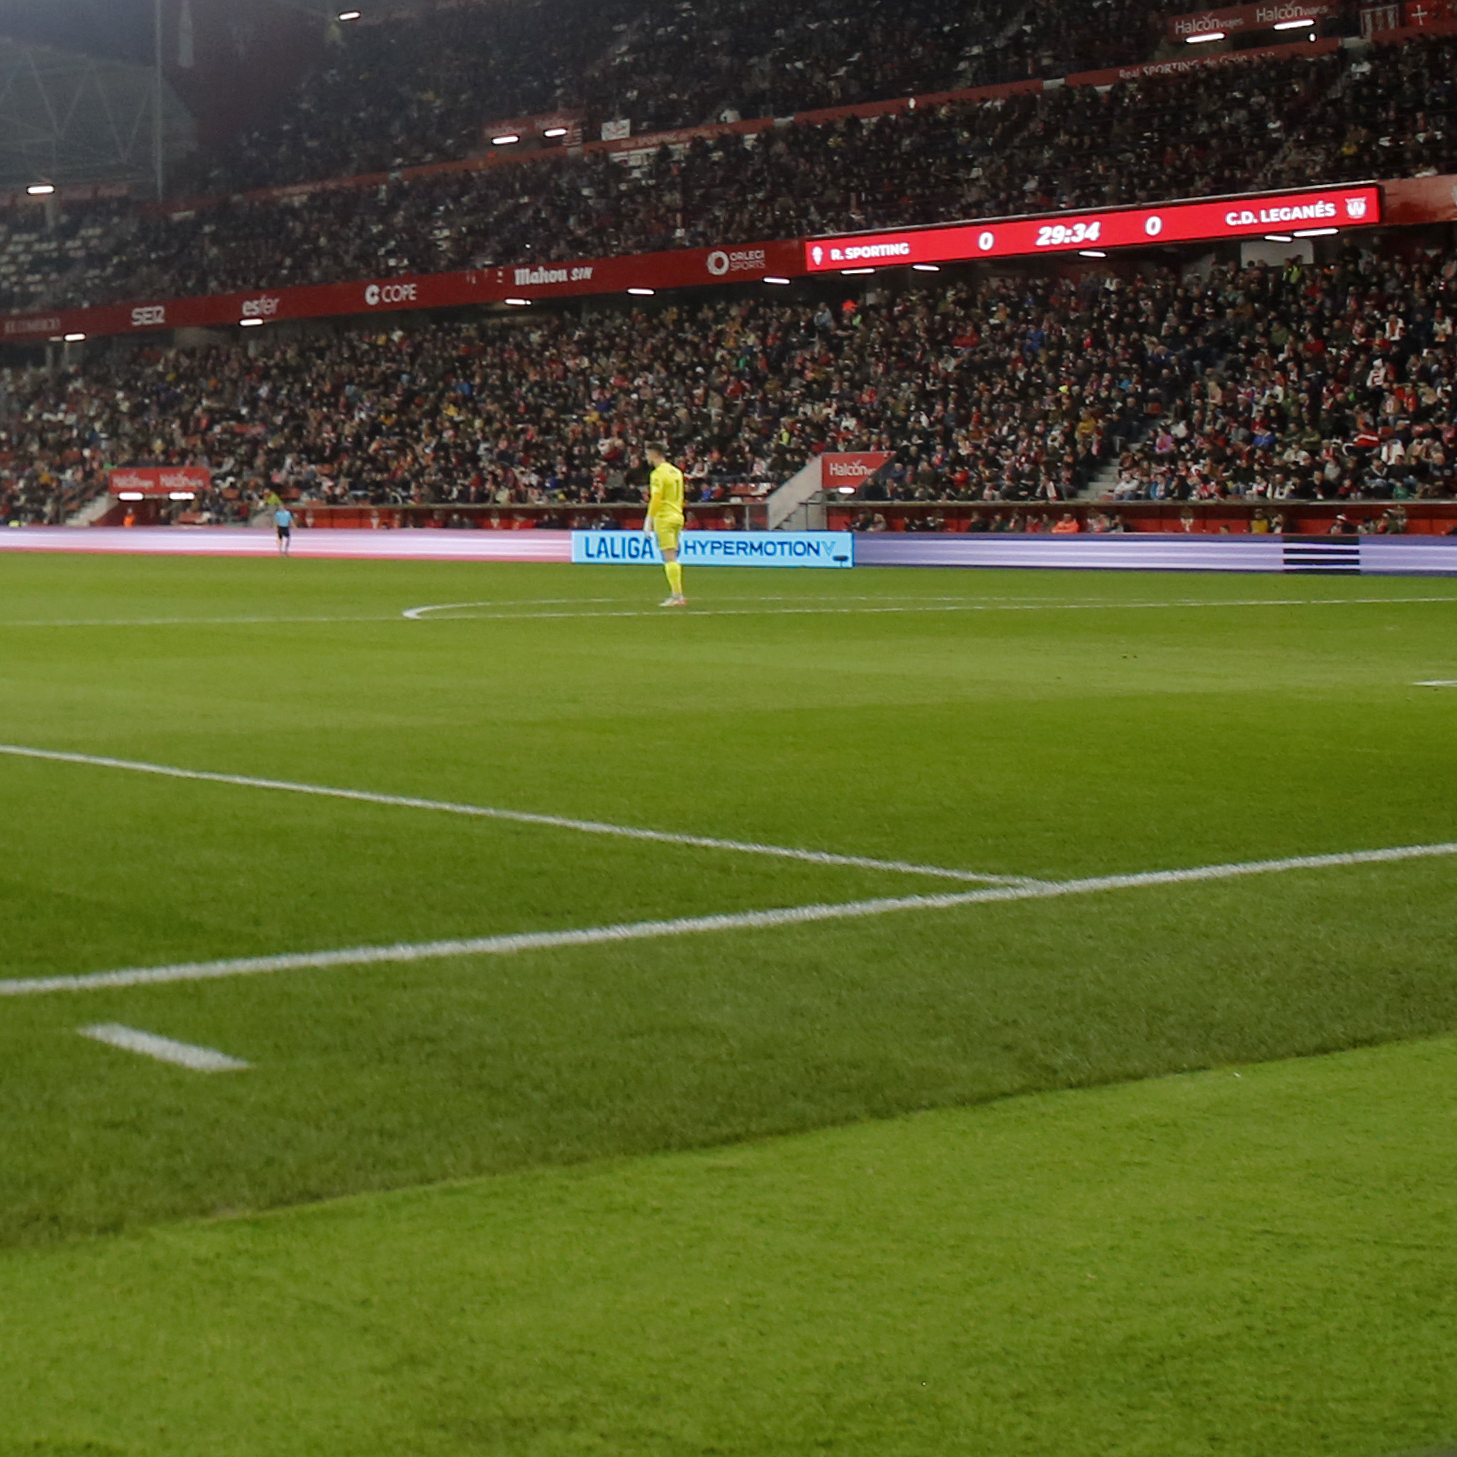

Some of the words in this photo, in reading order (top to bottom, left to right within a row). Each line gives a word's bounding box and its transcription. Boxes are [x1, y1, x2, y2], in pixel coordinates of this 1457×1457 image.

[1225, 211, 1257, 226] C.D.
[1260, 201, 1337, 223] LEGANÉS
[1036, 221, 1101, 246] 29:34
[1145, 215, 1163, 236] 0
[830, 248, 844, 261] R.
[845, 242, 910, 260] SPORTING
[978, 231, 995, 251] 0
[729, 249, 765, 262] ORLEGI
[514, 266, 568, 286] Mahou
[381, 283, 418, 304] COPE
[584, 537, 655, 559] LALIGA
